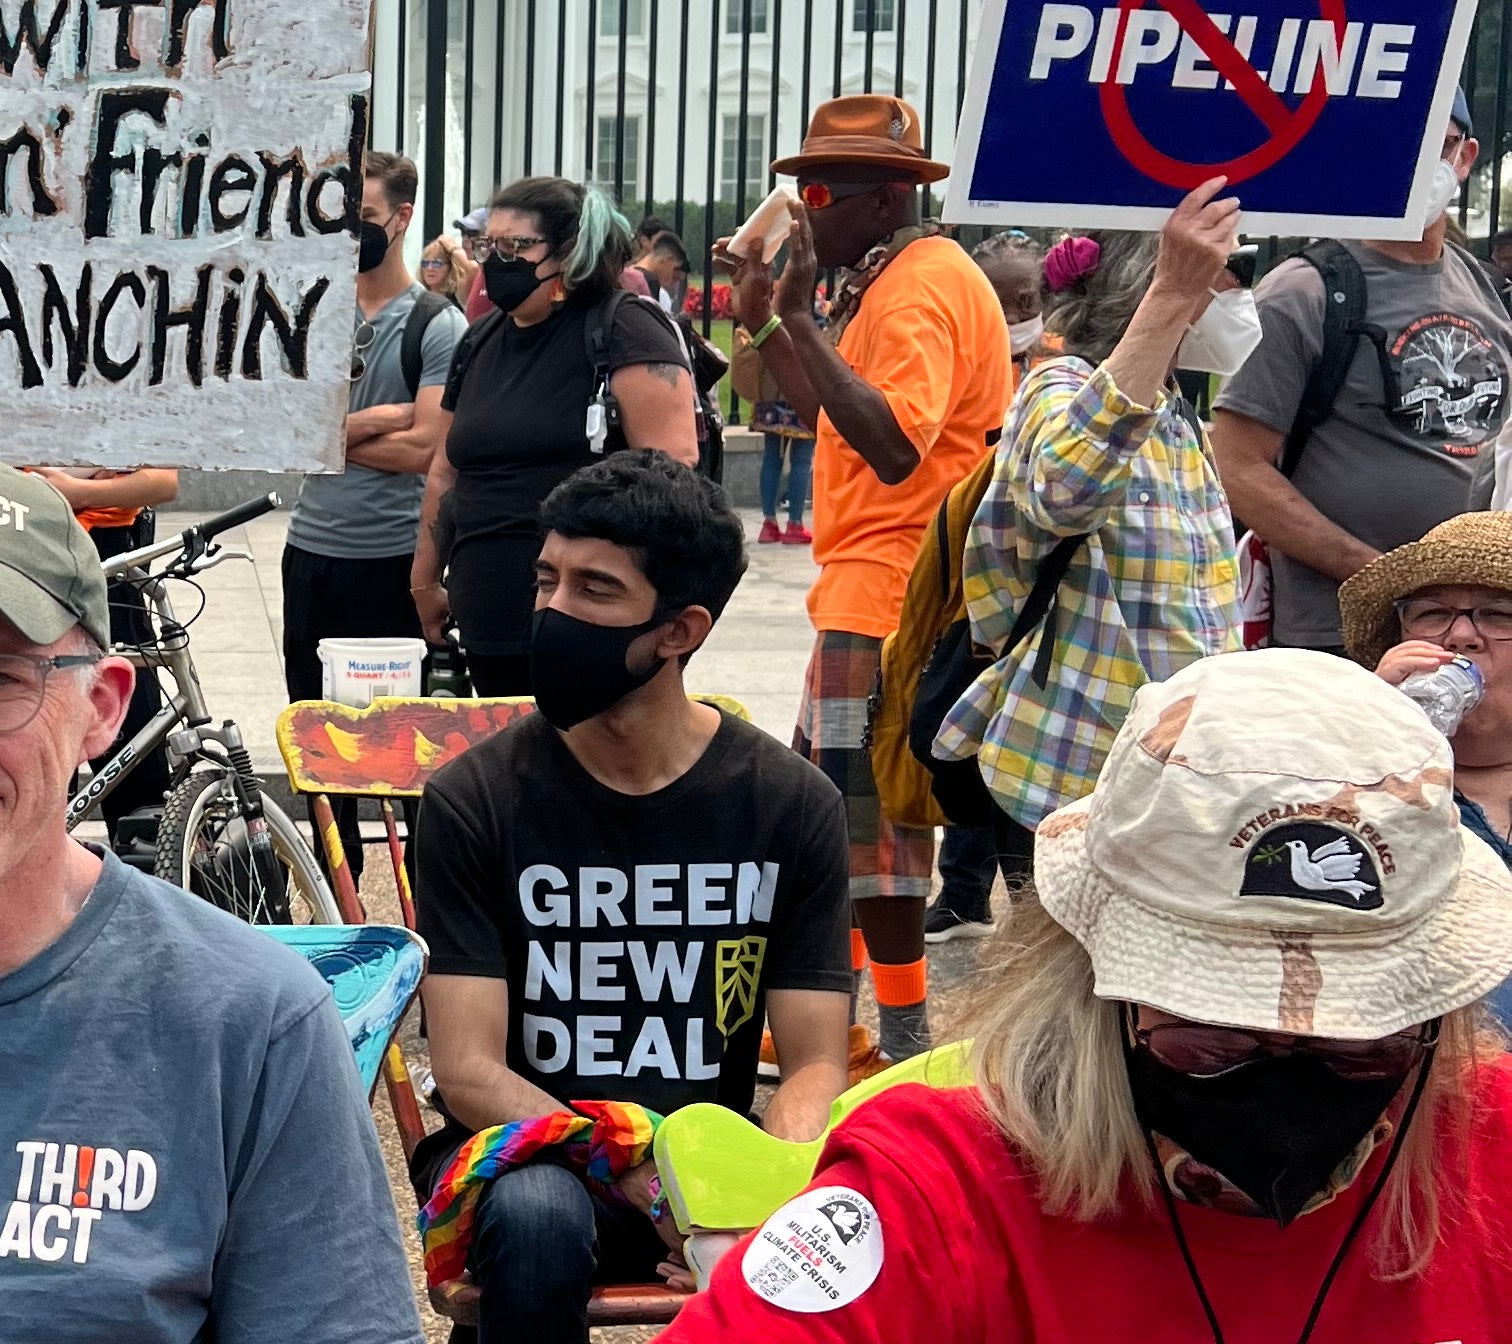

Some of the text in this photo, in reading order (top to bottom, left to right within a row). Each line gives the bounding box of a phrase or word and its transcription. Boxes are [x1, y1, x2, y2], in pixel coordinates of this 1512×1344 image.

[1028, 3, 1416, 99] PIPELINE
[93, 89, 369, 242] Friend
[1229, 802, 1396, 875] VETERANS FOR PEACE
[518, 862, 779, 927] GREEN
[525, 941, 704, 1002] NEW
[523, 1013, 720, 1079] DEAL
[763, 1231, 840, 1300] CLIMATE CRISIS
[786, 1220, 847, 1274] MILITARISM
[788, 1235, 823, 1268] FUELS
[811, 1224, 831, 1247] U.S.
